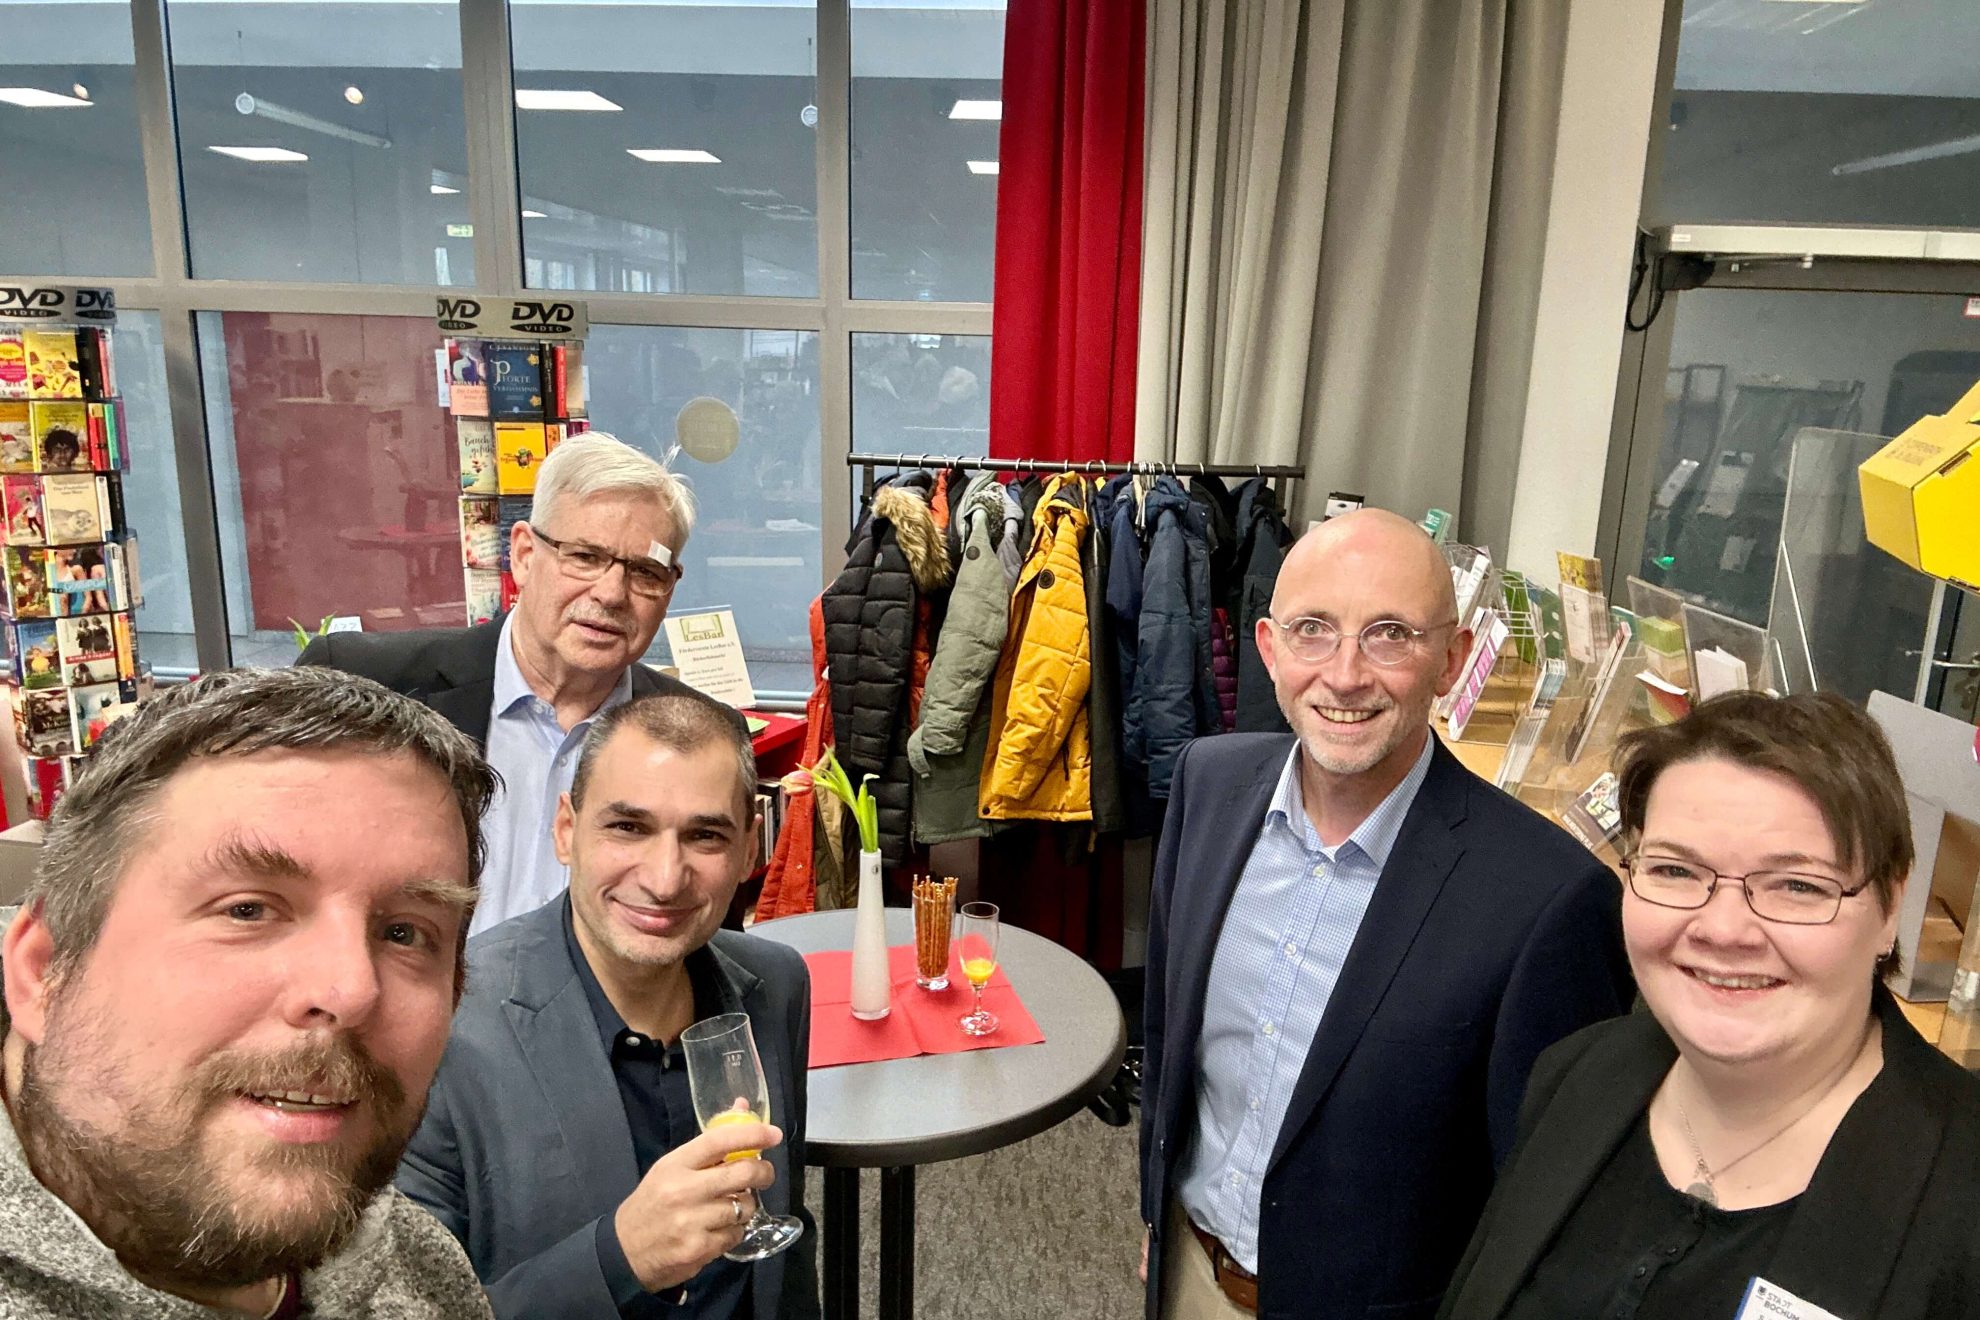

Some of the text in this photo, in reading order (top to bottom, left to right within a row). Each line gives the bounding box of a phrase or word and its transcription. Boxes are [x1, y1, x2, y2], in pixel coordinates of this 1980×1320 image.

[512, 302, 575, 324] DVD
[524, 325, 563, 333] VIDEO
[685, 632, 724, 641] LesBar
[1764, 1300, 1800, 1320] BOCHUM
